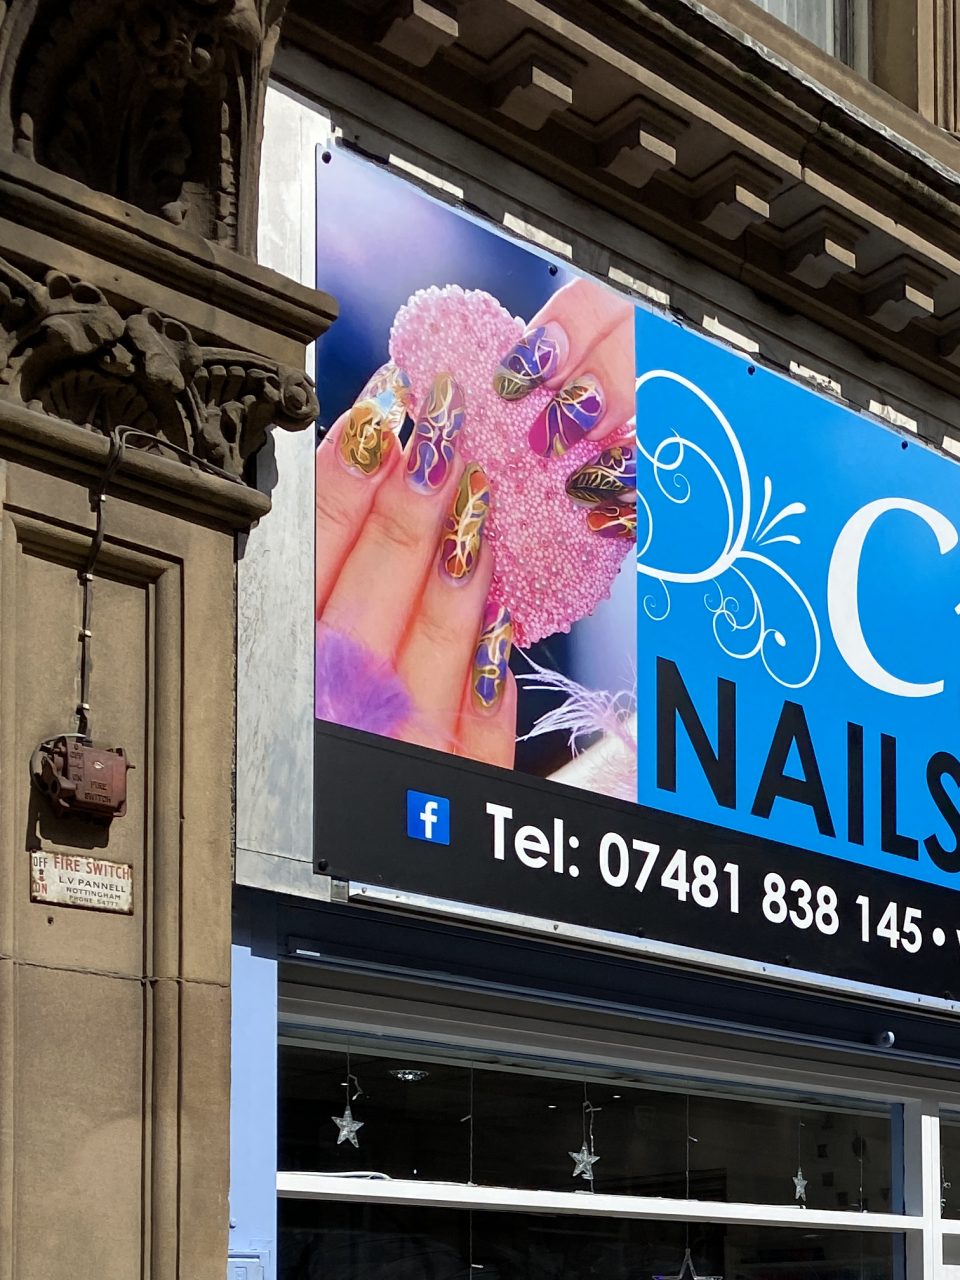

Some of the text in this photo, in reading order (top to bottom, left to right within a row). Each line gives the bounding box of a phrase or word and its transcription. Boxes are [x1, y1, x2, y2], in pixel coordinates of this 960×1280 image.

[84, 791, 112, 804] SWITCH
[33, 855, 49, 869] OFF
[54, 854, 130, 881] FIRE SWITCH
[486, 802, 580, 878] Tel:
[599, 831, 740, 915] 07481
[762, 872, 839, 936] 838
[66, 886, 121, 901] NOTTINGHAM
[78, 878, 127, 894] PANNELL
